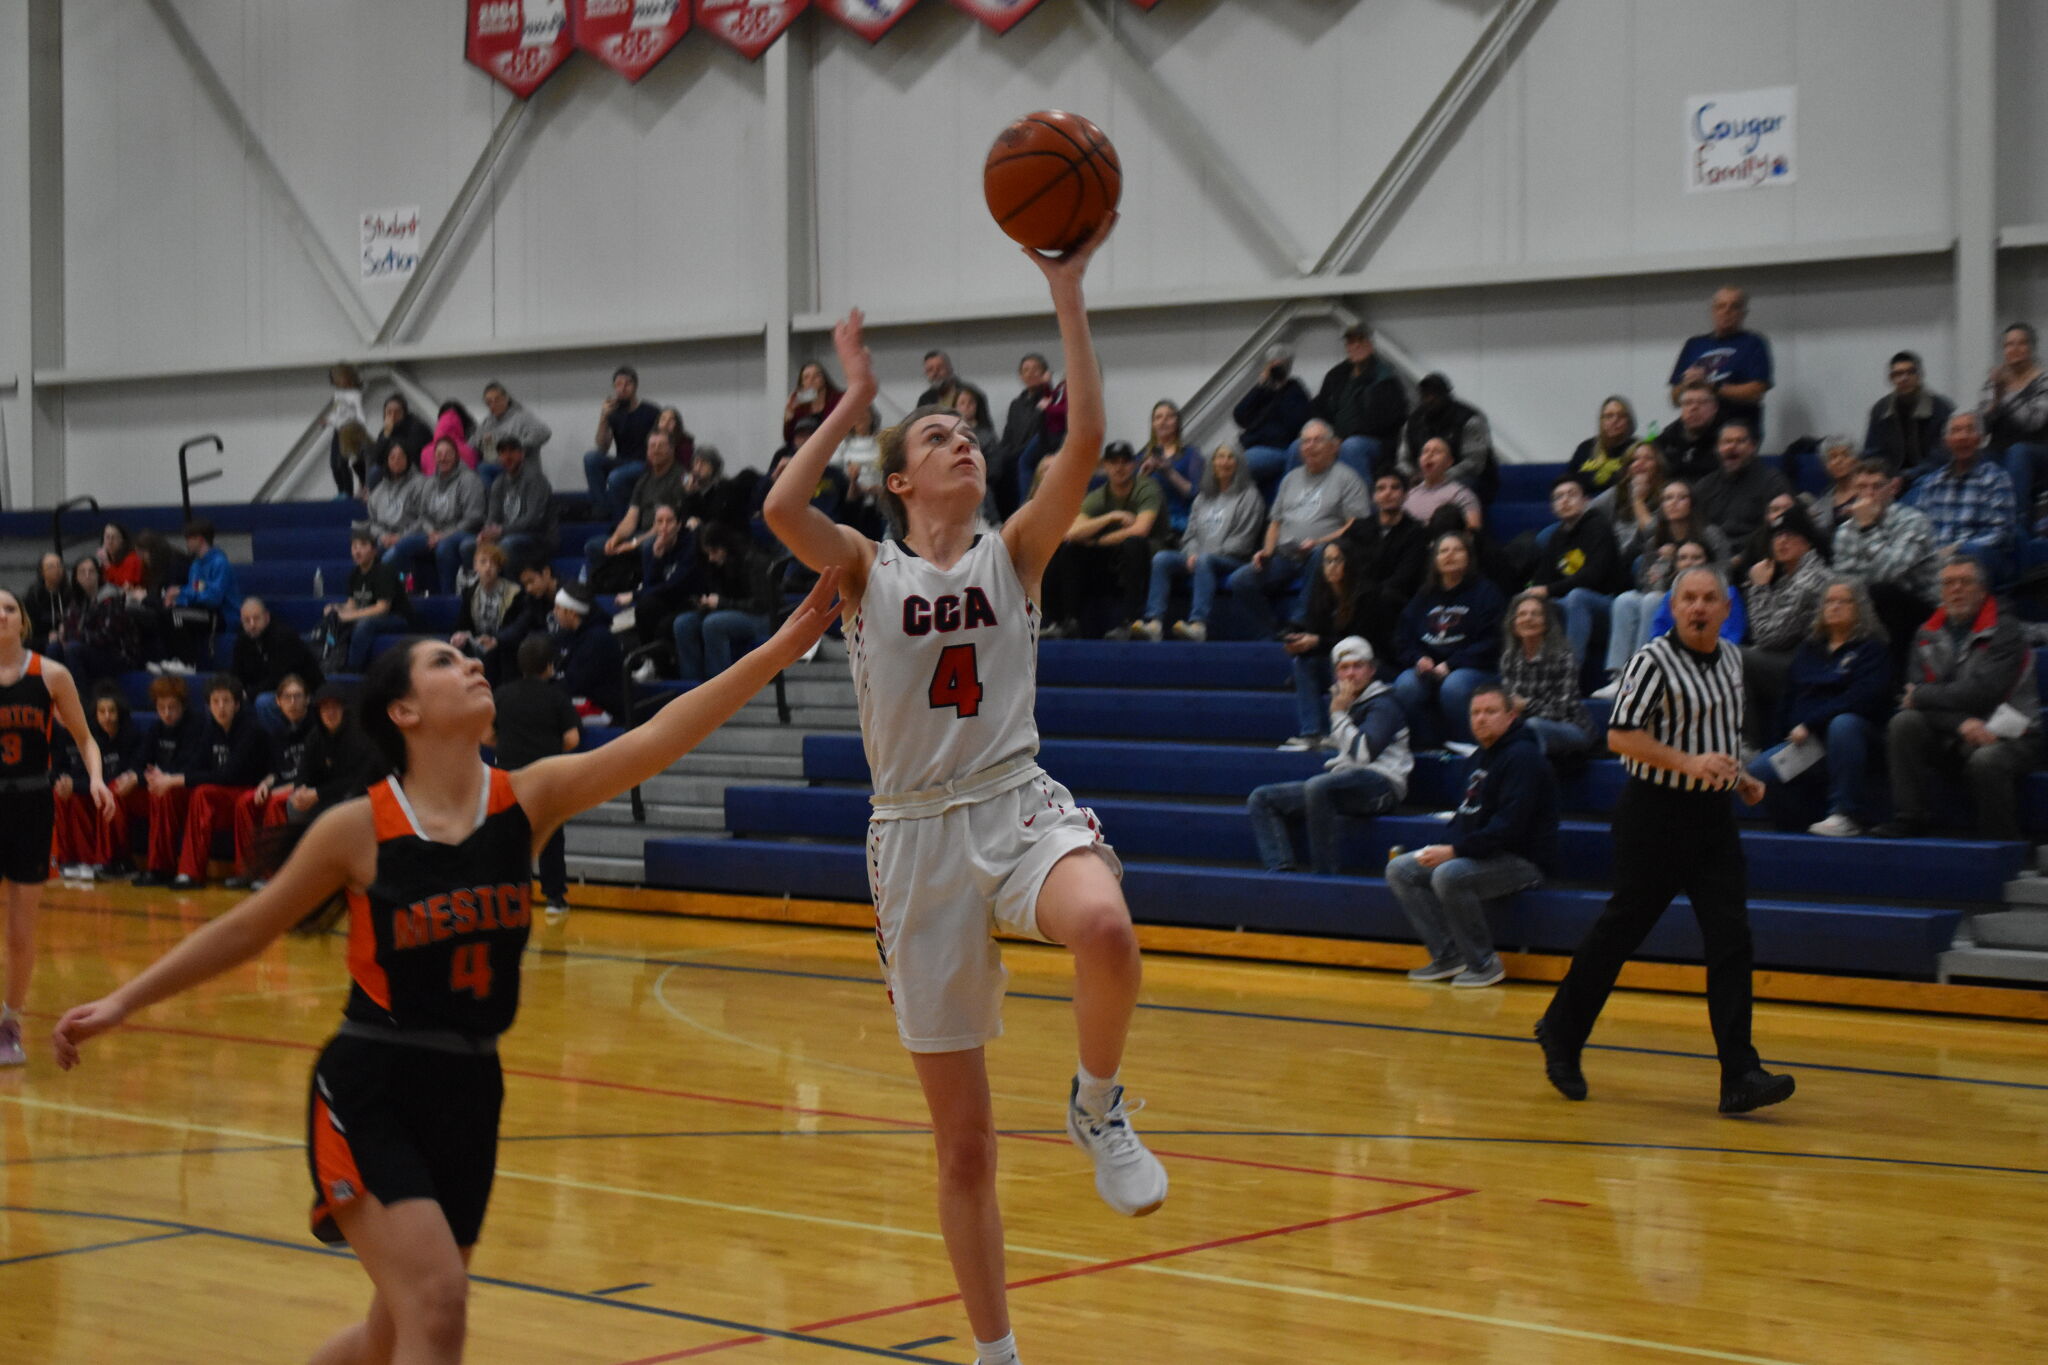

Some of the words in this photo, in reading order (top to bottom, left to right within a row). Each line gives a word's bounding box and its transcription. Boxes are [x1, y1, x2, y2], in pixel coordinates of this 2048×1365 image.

[1694, 102, 1786, 154] Cougar
[1696, 143, 1768, 186] Family
[902, 586, 998, 637] CCA
[928, 643, 983, 719] 4
[452, 943, 493, 998] 4
